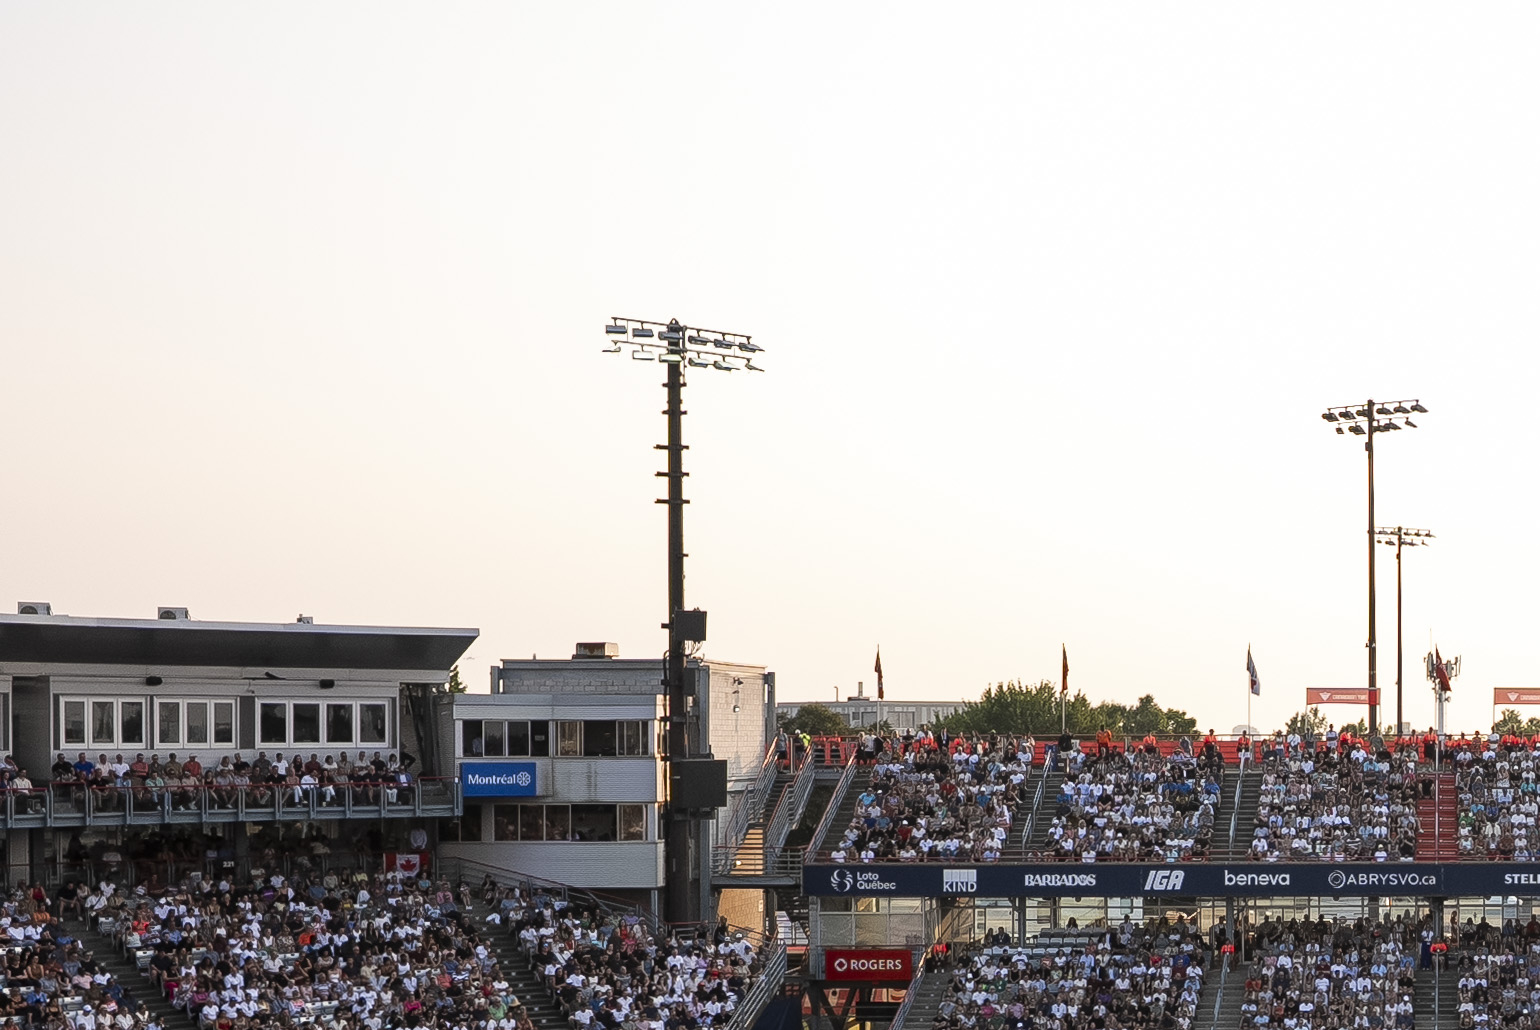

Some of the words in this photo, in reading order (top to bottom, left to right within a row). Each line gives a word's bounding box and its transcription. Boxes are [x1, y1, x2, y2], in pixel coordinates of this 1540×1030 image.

[467, 770, 516, 786] Montréal
[857, 872, 879, 880] Loto
[1024, 874, 1096, 886] BARBADOS
[1144, 870, 1185, 890] IGA
[1224, 870, 1290, 886] beneva
[1346, 873, 1436, 886] ABRYSVO.ca
[857, 880, 896, 890] Québec
[943, 882, 977, 892] KIND
[849, 958, 902, 971] ROGERS
